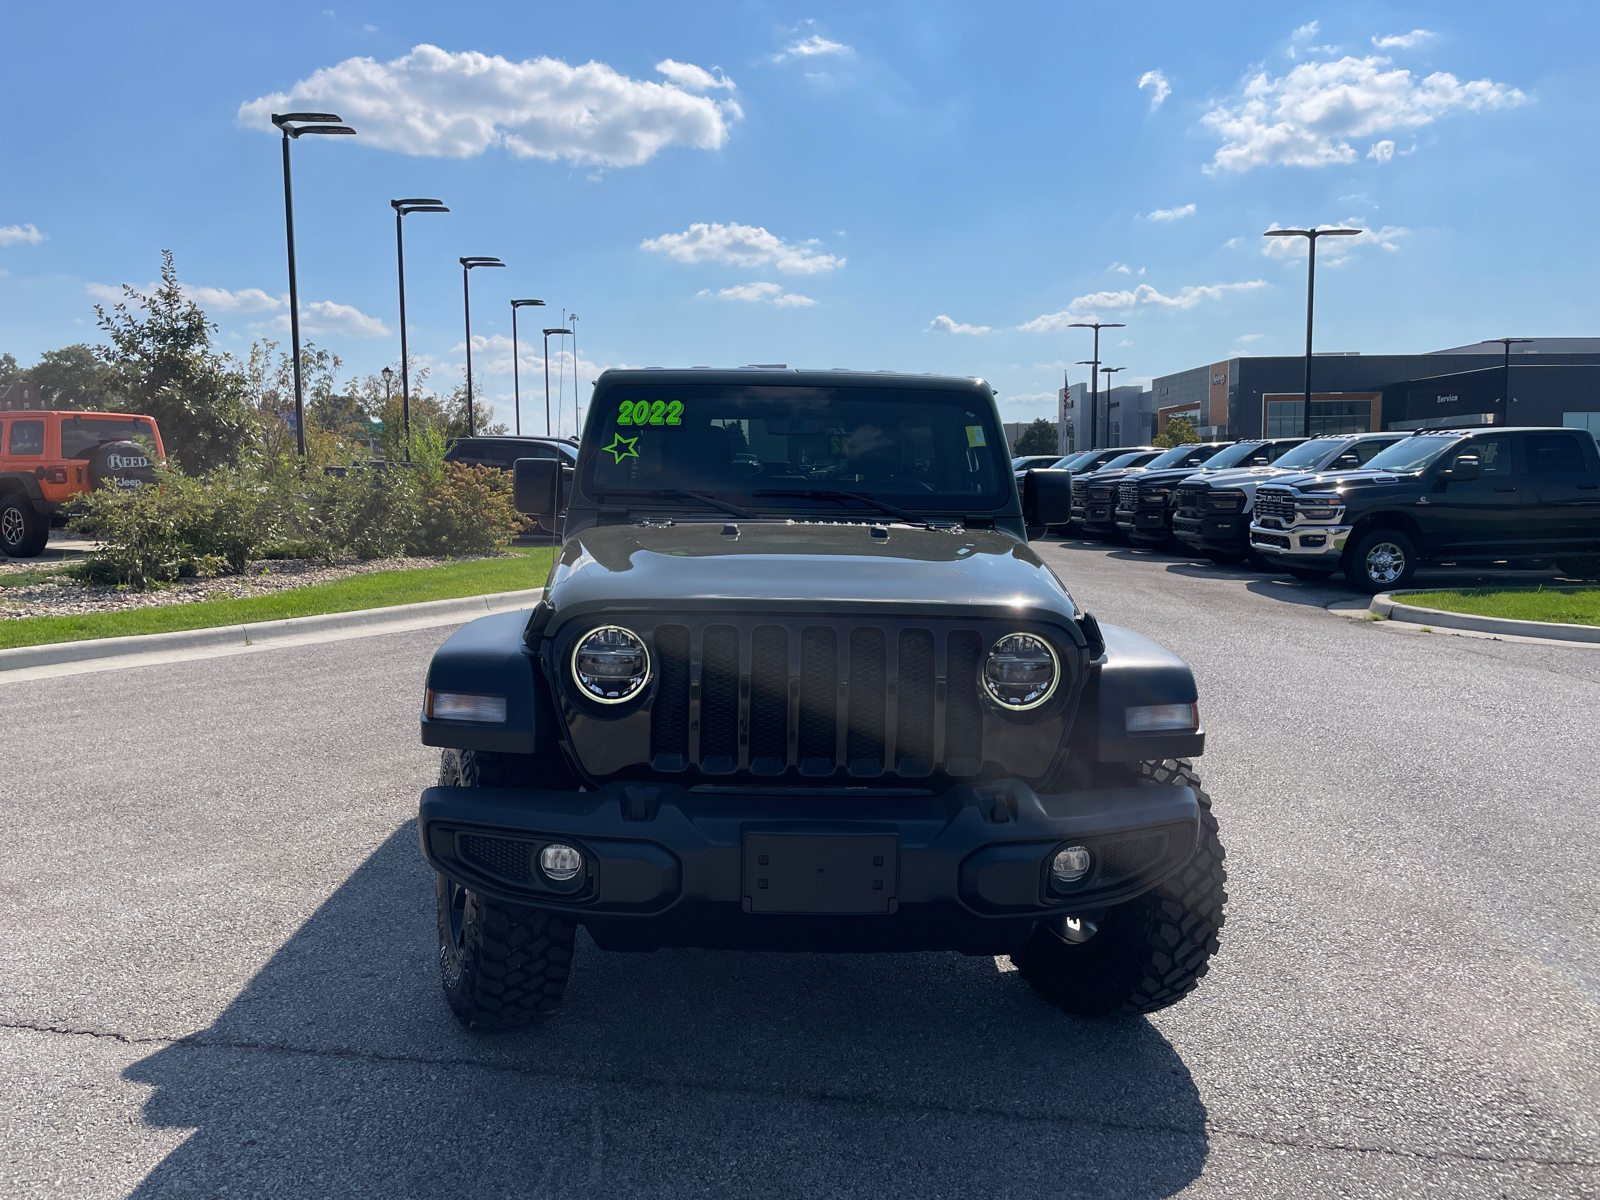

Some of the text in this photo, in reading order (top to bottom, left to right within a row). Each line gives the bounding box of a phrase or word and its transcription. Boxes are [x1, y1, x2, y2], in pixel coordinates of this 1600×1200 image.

[1436, 393, 1458, 403] Service
[617, 400, 684, 426] 2022
[108, 454, 147, 470] REED
[118, 477, 141, 488] Jeep
